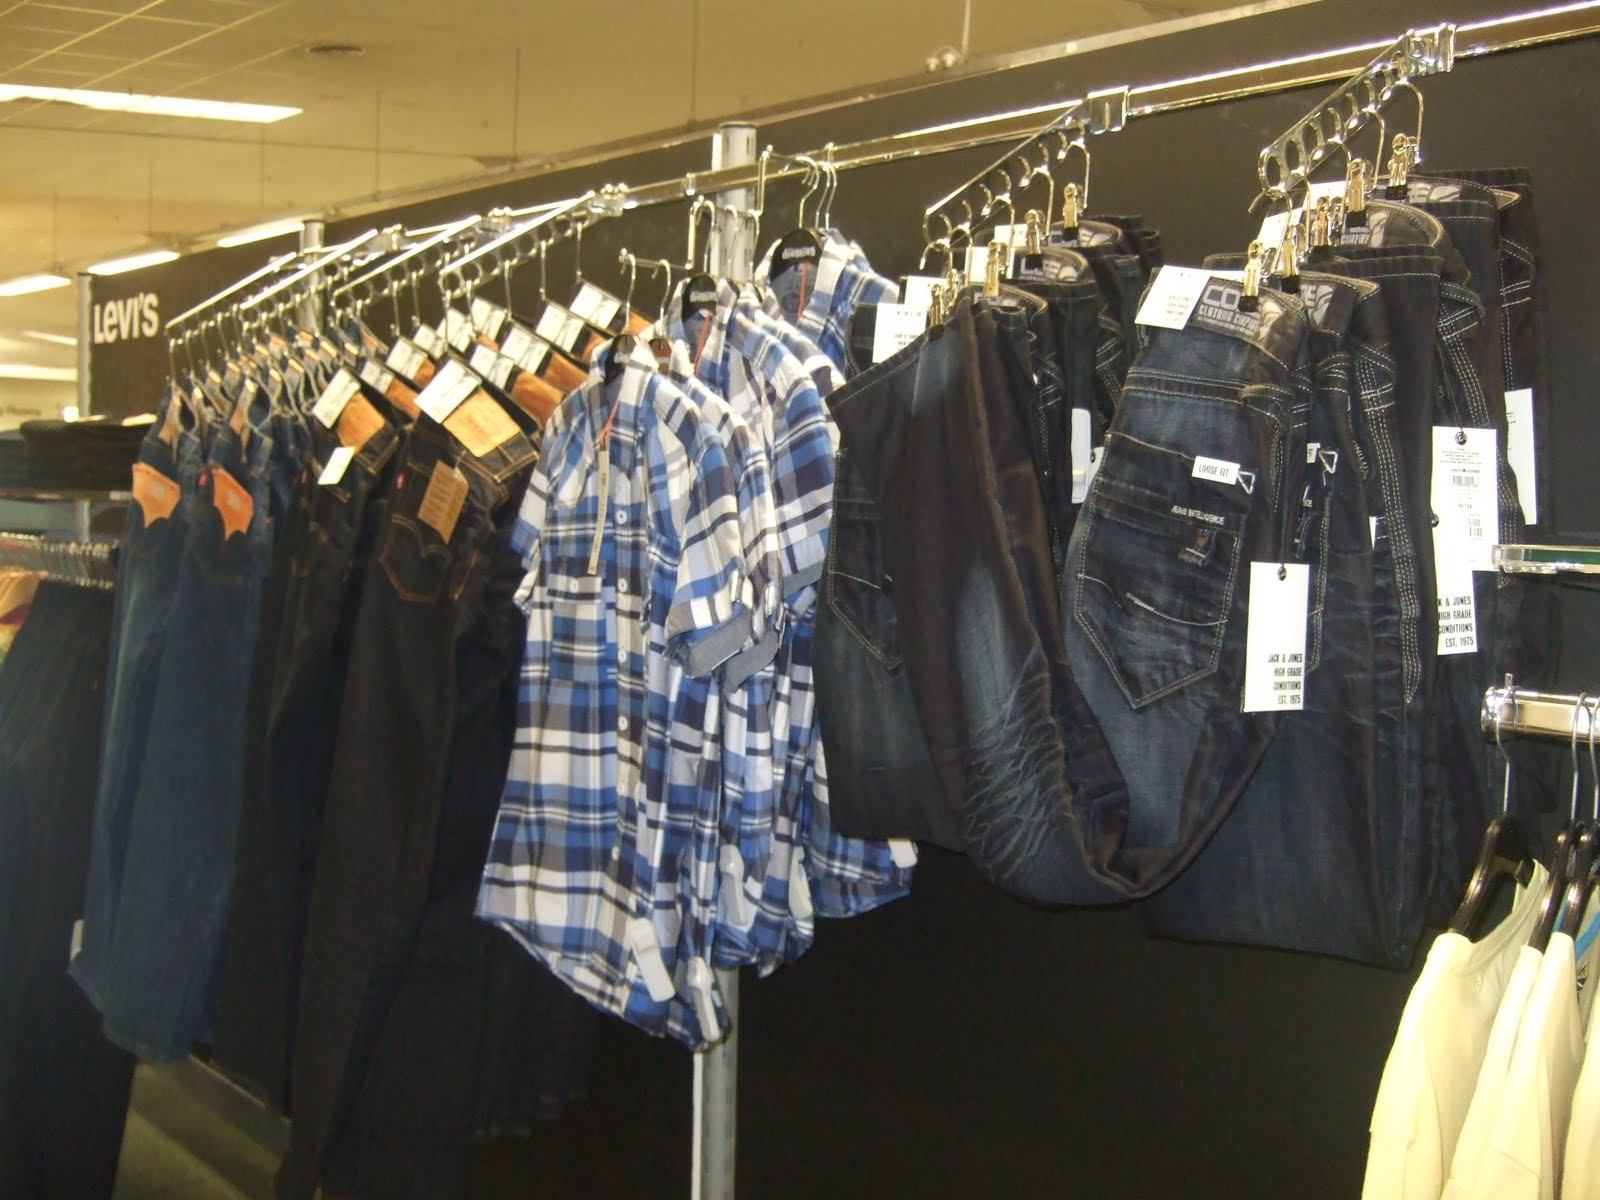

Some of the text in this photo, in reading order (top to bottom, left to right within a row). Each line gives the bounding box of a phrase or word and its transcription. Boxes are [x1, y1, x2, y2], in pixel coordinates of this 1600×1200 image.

[1198, 464, 1230, 478] LOOSE FIT
[1445, 597, 1450, 606] &
[1453, 596, 1471, 606] JONES
[1438, 609, 1472, 621] HIGH GRADE
[1439, 623, 1473, 635] CONDITIONS
[1459, 636, 1474, 646] 1975
[1268, 653, 1280, 663] JACK
[1288, 653, 1302, 663] JONES
[1274, 666, 1302, 676] HIGH GRADE
[1273, 681, 1302, 690] CONDITIONS
[1289, 694, 1301, 704] 1975
